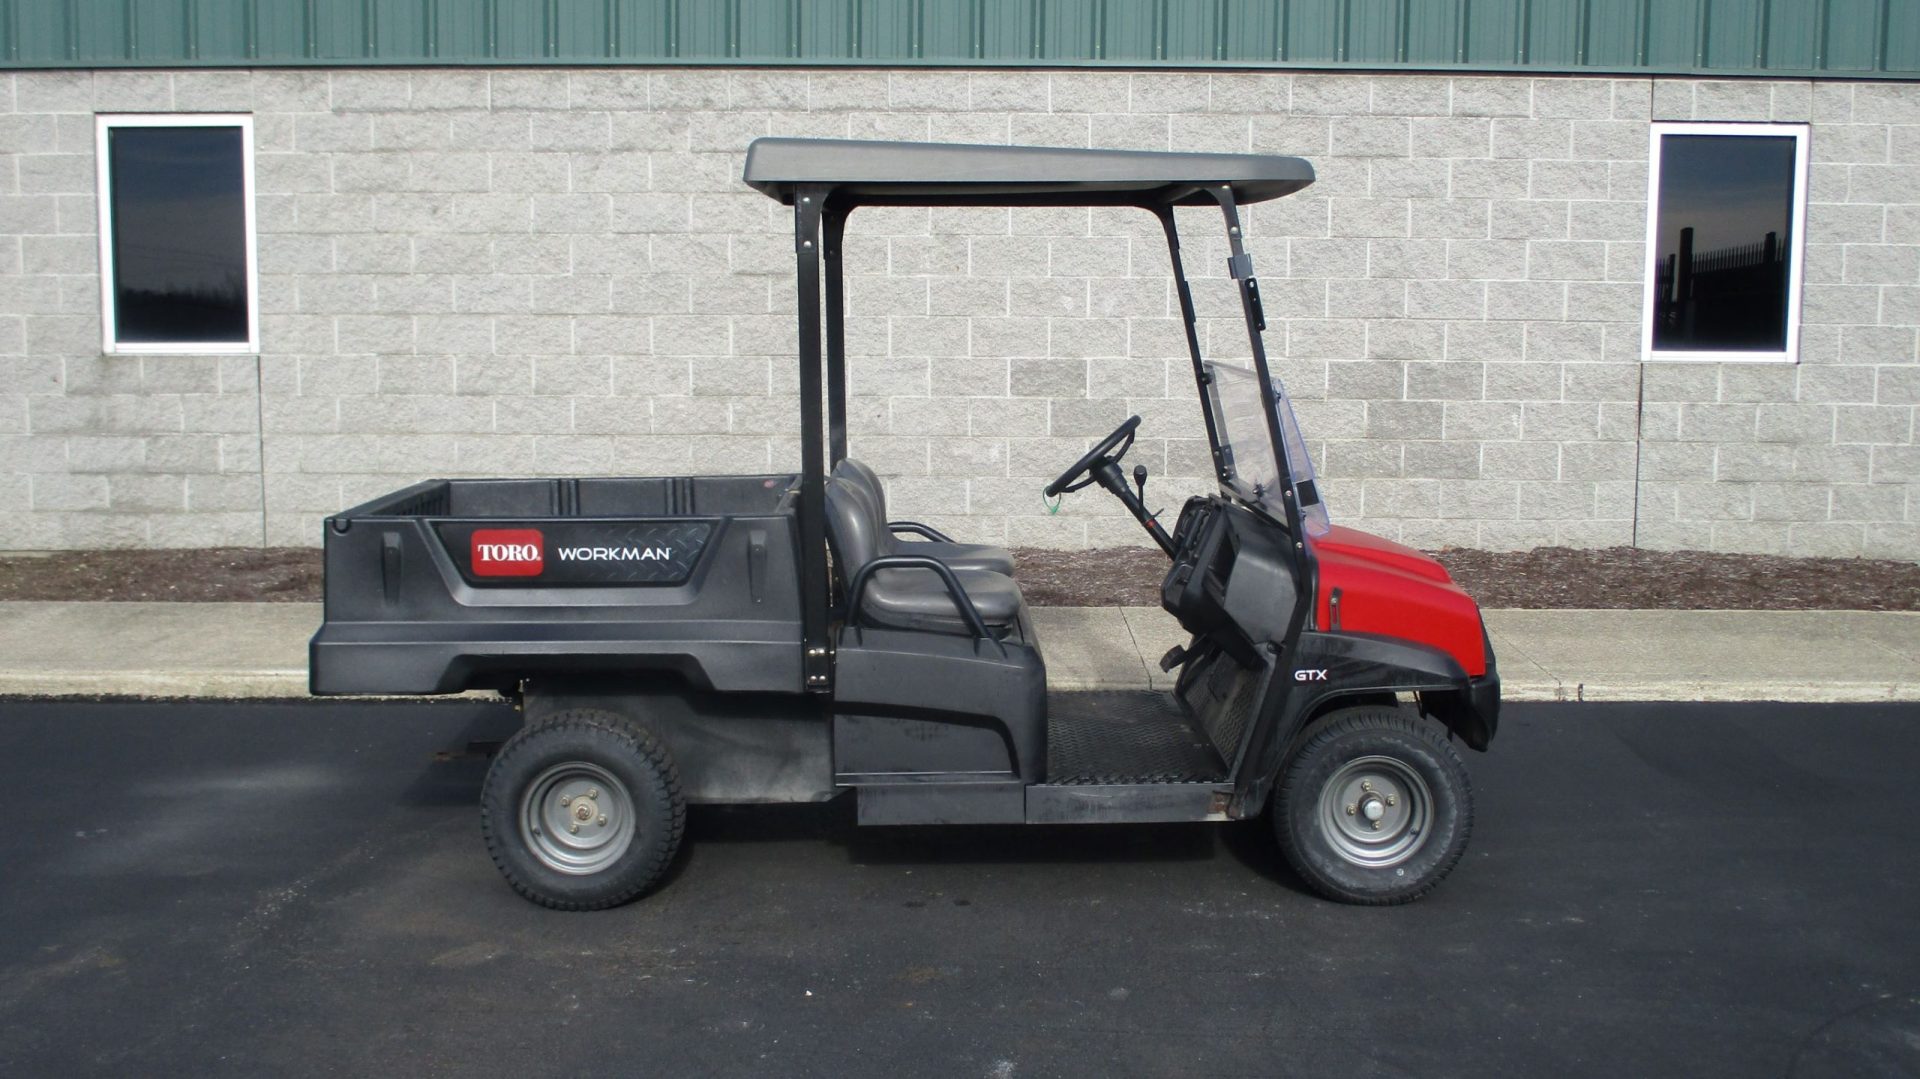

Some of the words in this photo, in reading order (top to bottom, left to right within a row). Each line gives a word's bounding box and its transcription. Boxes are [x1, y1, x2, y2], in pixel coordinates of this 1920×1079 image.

[478, 544, 539, 561] TORO
[558, 547, 670, 561] WORKMAN
[1294, 669, 1328, 681] GTX
